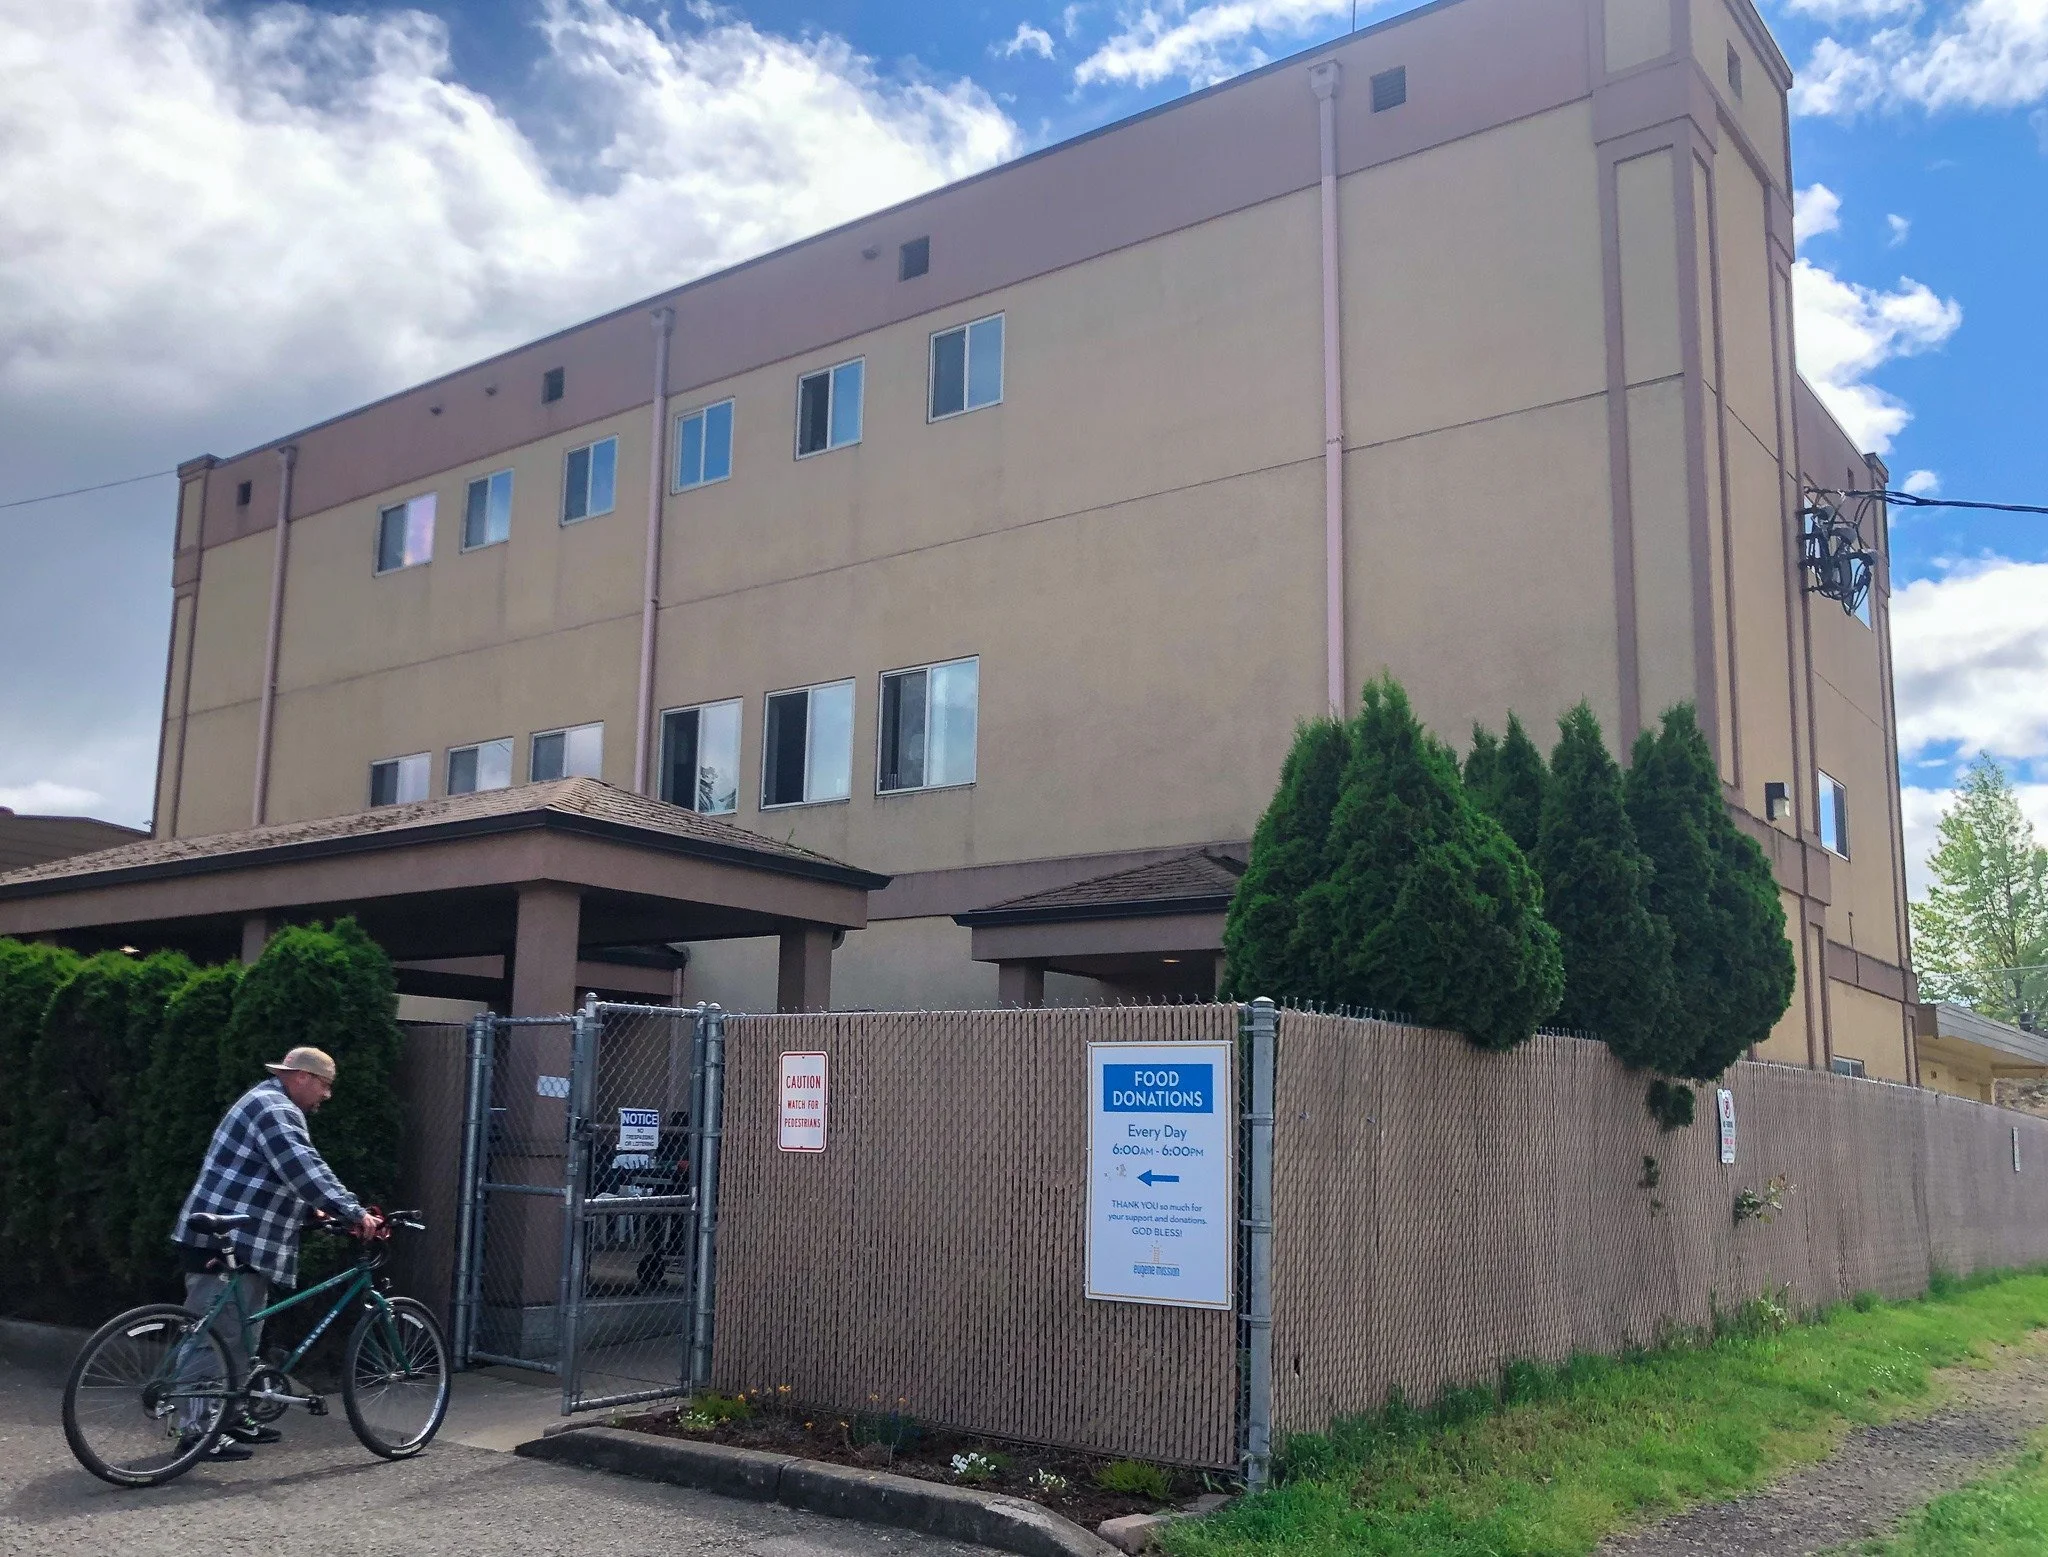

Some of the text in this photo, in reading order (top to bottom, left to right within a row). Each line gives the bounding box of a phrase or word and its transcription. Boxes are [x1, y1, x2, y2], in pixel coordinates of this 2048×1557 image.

[786, 1075, 821, 1089] CAUTION
[1134, 1070, 1180, 1087] FOOD
[787, 1100, 819, 1110] WATCH FOR
[1113, 1090, 1203, 1107] DONATIONS
[623, 1112, 658, 1125] NOTICE
[784, 1118, 821, 1128] PEDESTRIANS
[1128, 1124, 1187, 1141] Every Day
[1112, 1143, 1154, 1156] 6:00AM
[1161, 1144, 1204, 1157] 6:00PM
[1112, 1199, 1140, 1209] THANK
[1141, 1201, 1159, 1210] YOU
[1169, 1203, 1190, 1211] much
[1191, 1203, 1202, 1212] for
[1125, 1214, 1153, 1223] support
[1170, 1215, 1207, 1225] donations.
[1131, 1227, 1183, 1238] GOD BLESS!
